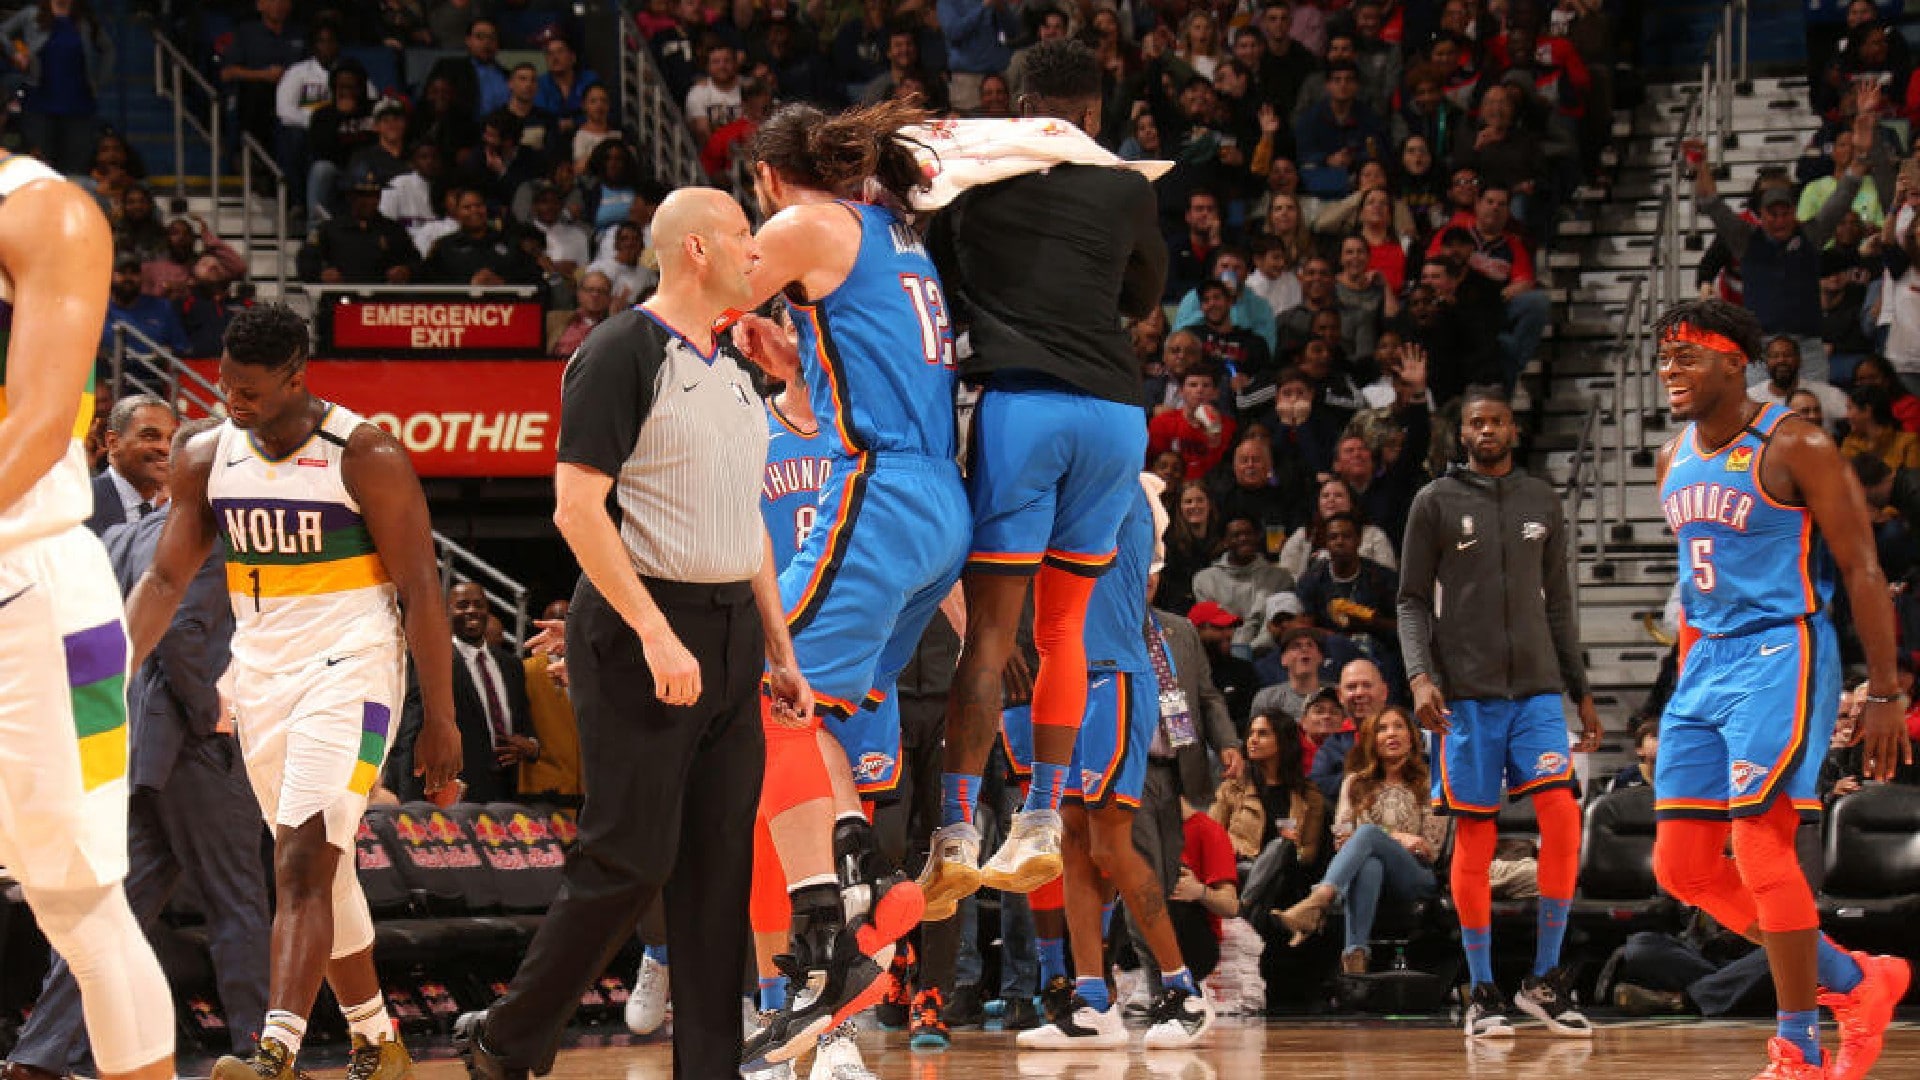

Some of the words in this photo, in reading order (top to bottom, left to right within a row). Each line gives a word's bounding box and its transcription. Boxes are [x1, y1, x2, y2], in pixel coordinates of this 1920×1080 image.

[361, 305, 514, 326] EMERGENCY
[411, 327, 466, 348] EXIT
[366, 411, 550, 453] OOTHIE
[224, 508, 323, 553] NOLA
[1690, 537, 1717, 593] 5
[249, 567, 260, 613] 1
